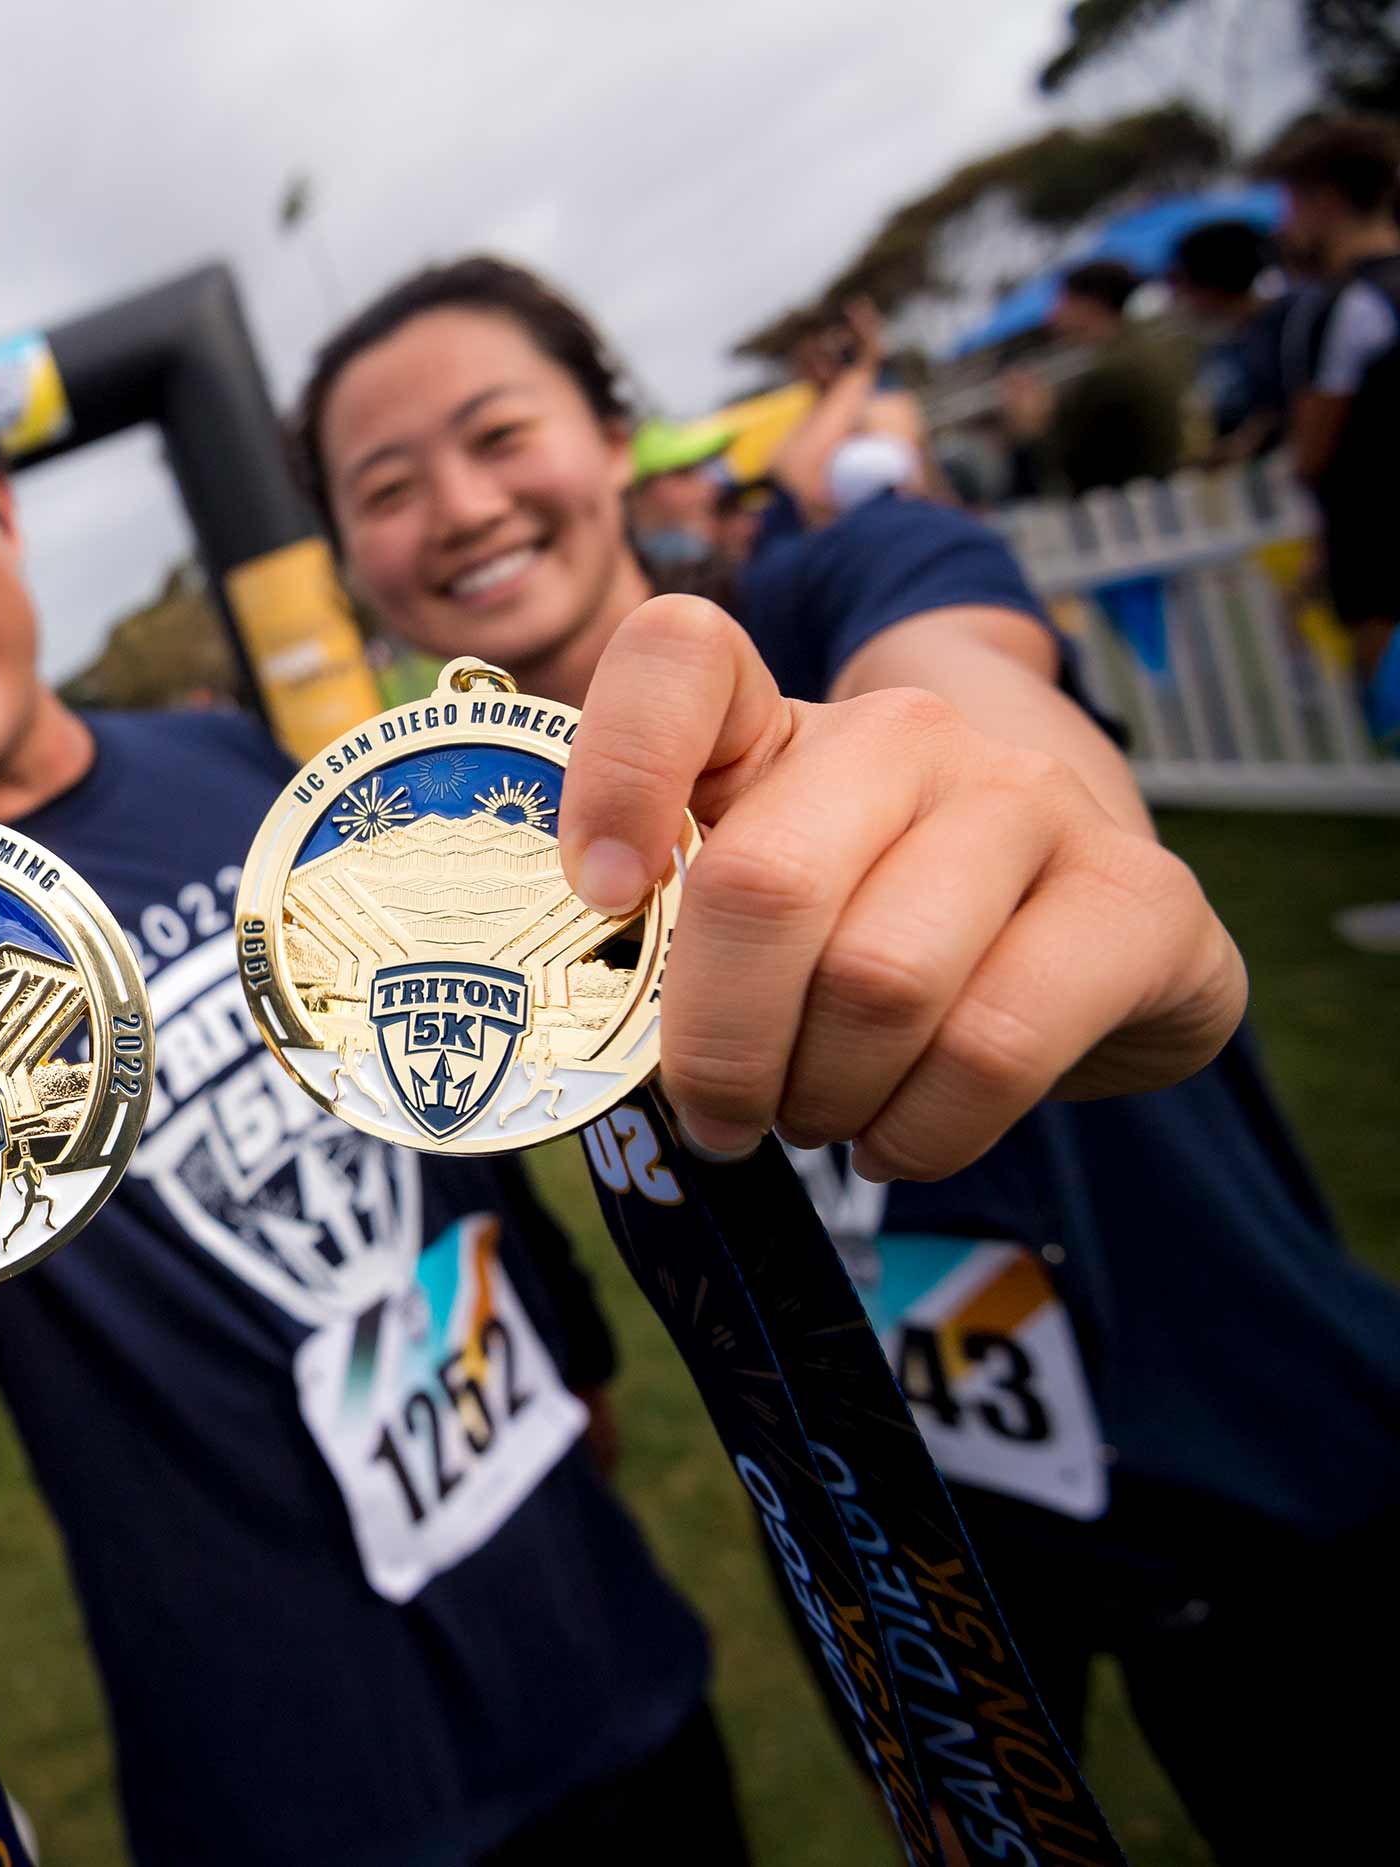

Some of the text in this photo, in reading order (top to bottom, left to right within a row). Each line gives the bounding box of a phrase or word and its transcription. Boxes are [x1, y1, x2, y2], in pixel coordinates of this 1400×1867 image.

[293, 771, 326, 804] UC
[326, 733, 374, 775] SAN
[379, 703, 458, 744] DIEGO
[242, 918, 274, 990] 1996
[377, 977, 521, 1021] TRITON
[412, 1011, 476, 1051] 5K
[109, 1012, 145, 1099] 2022
[369, 1316, 533, 1526] 1252
[901, 1544, 1006, 1664] 5K
